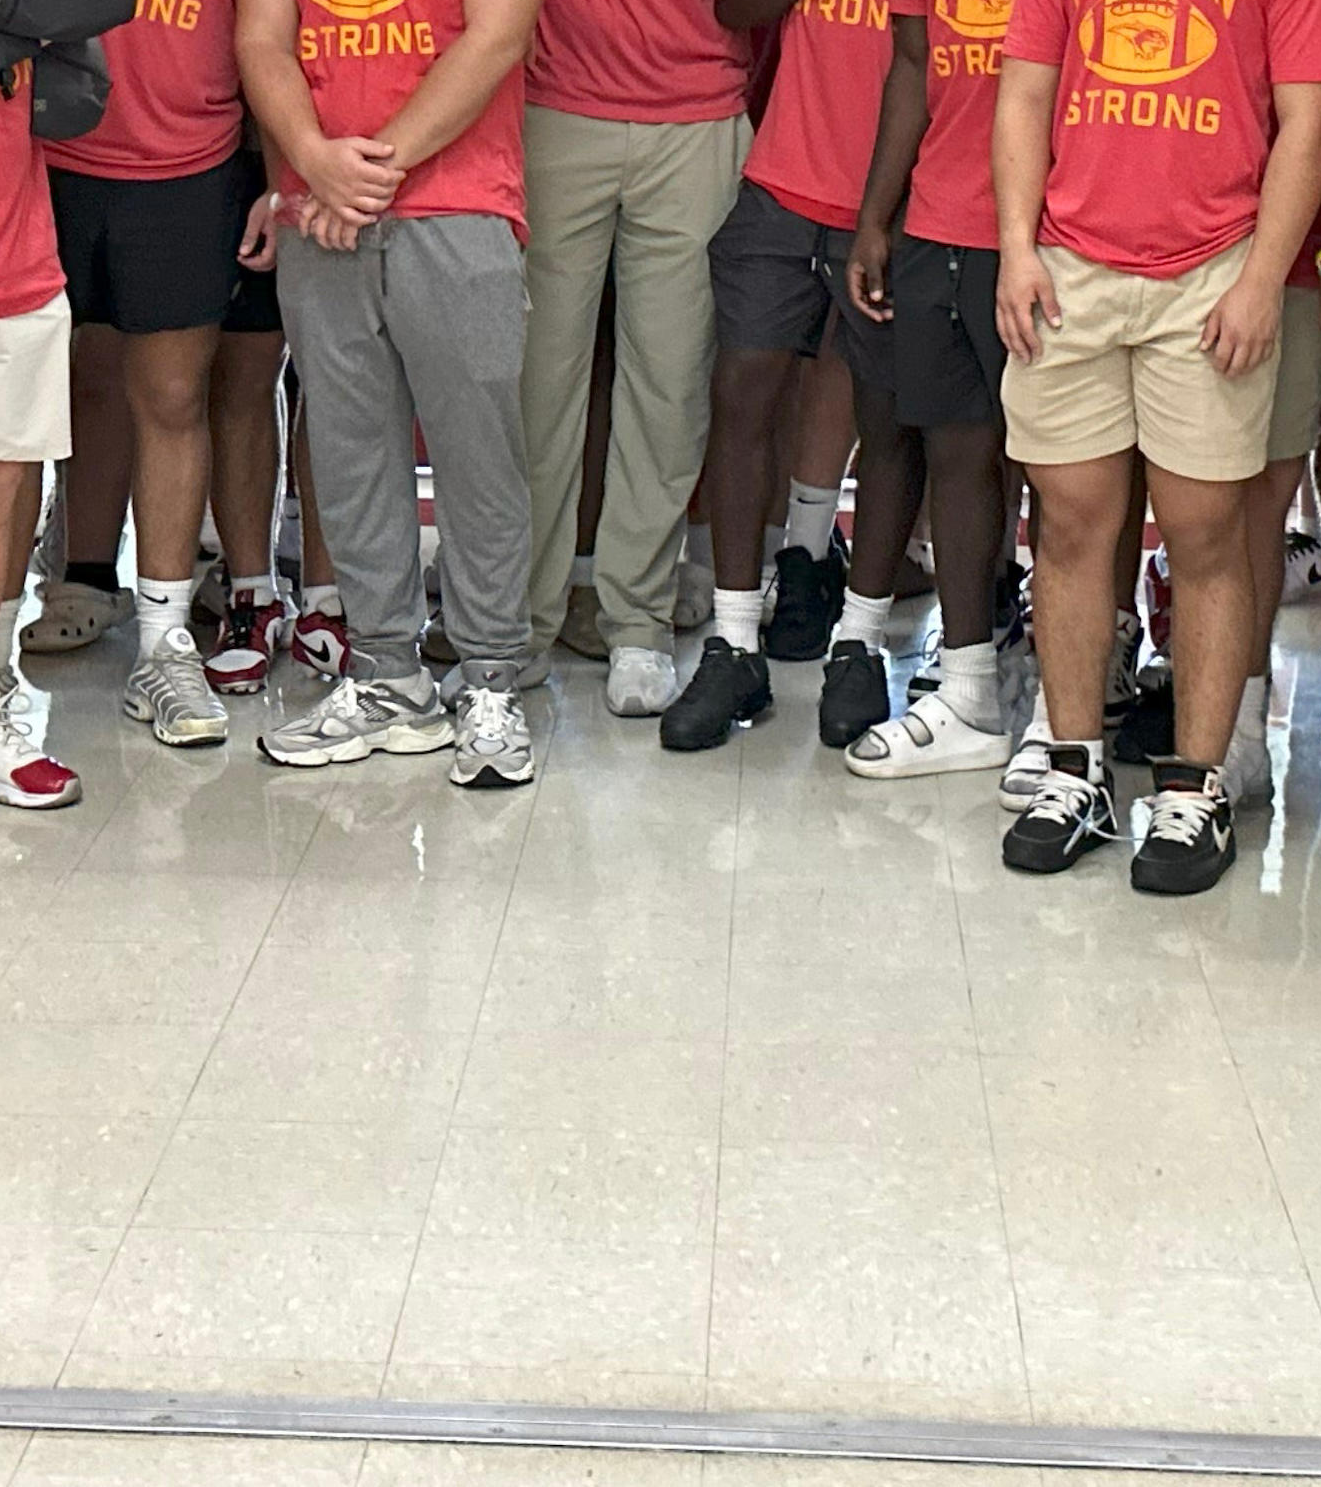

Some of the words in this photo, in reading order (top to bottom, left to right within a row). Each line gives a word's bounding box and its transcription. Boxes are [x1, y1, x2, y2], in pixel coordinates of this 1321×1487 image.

[300, 21, 436, 61] STRONG
[933, 43, 1004, 78] STRO
[1064, 88, 1222, 135] STRONG
